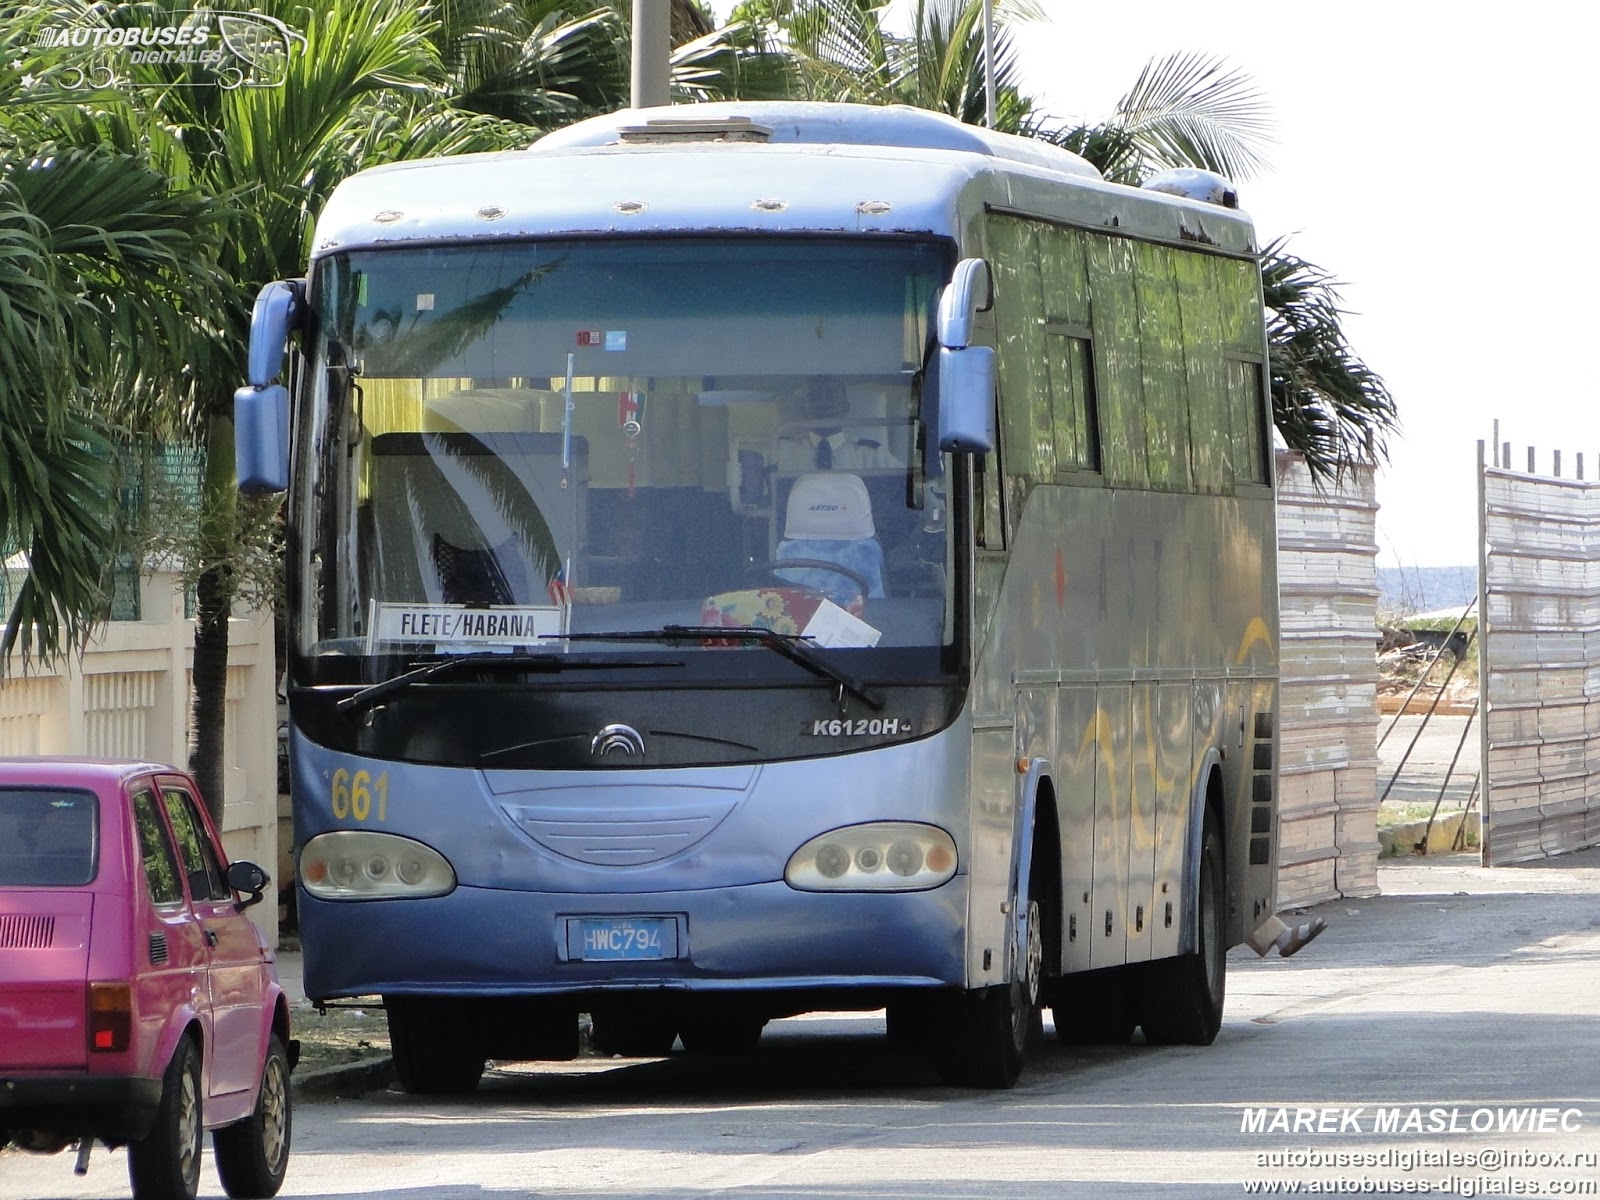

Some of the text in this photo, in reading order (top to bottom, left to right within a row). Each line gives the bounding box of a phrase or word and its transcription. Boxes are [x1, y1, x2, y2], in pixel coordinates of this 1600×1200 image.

[401, 613, 535, 638] FLETE/HABANA
[332, 767, 389, 822] 661
[583, 928, 662, 950] HWC794
